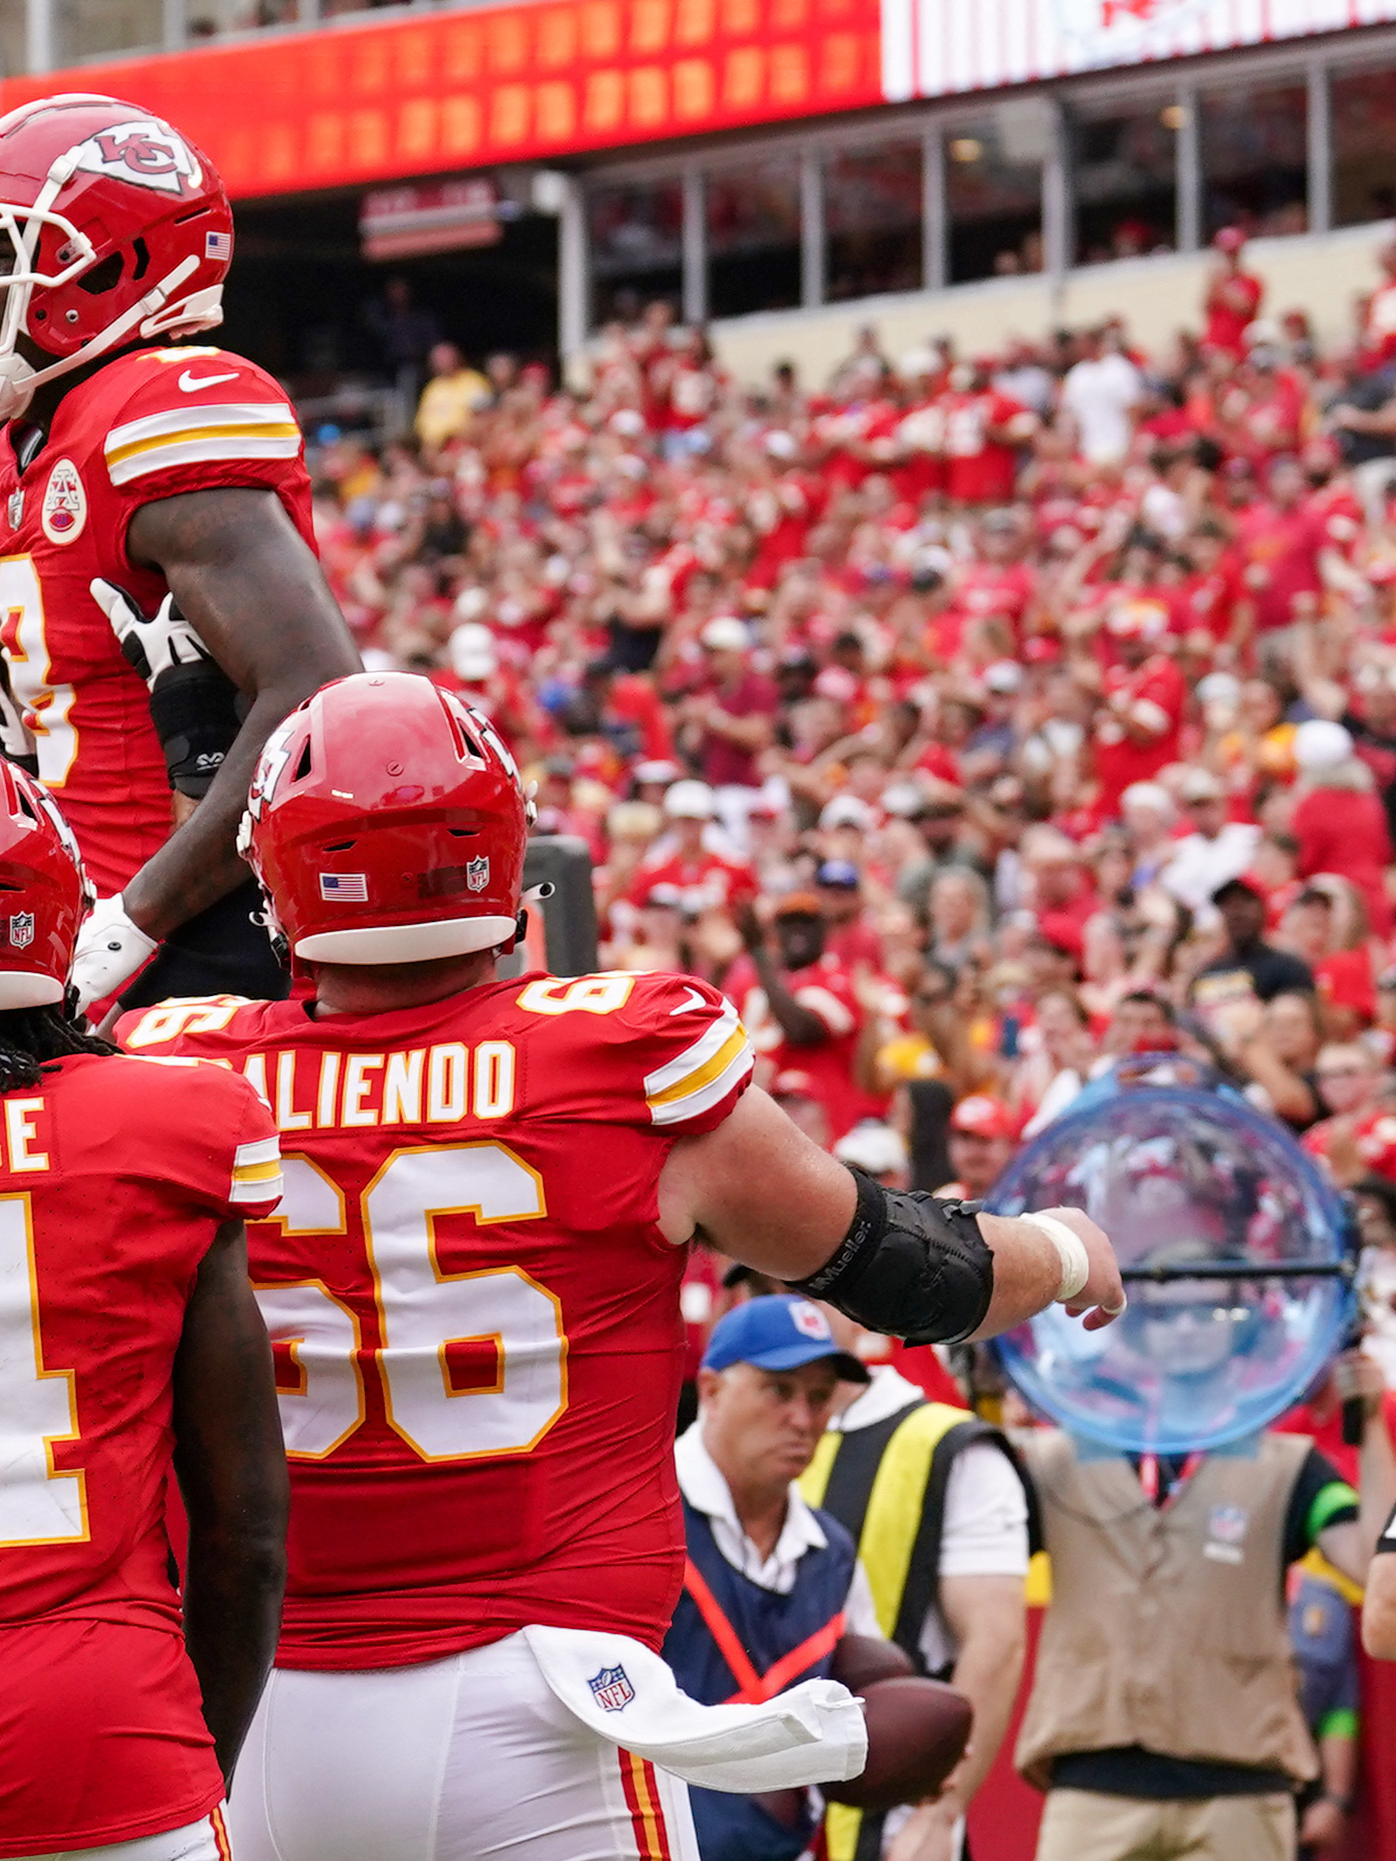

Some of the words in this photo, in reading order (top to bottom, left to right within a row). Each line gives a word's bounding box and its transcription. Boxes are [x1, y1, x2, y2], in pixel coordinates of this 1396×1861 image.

[93, 132, 178, 175] KC
[207, 1040, 516, 1132] ALIENDO
[245, 1139, 568, 1463] 66
[597, 1682, 632, 1709] NFL
